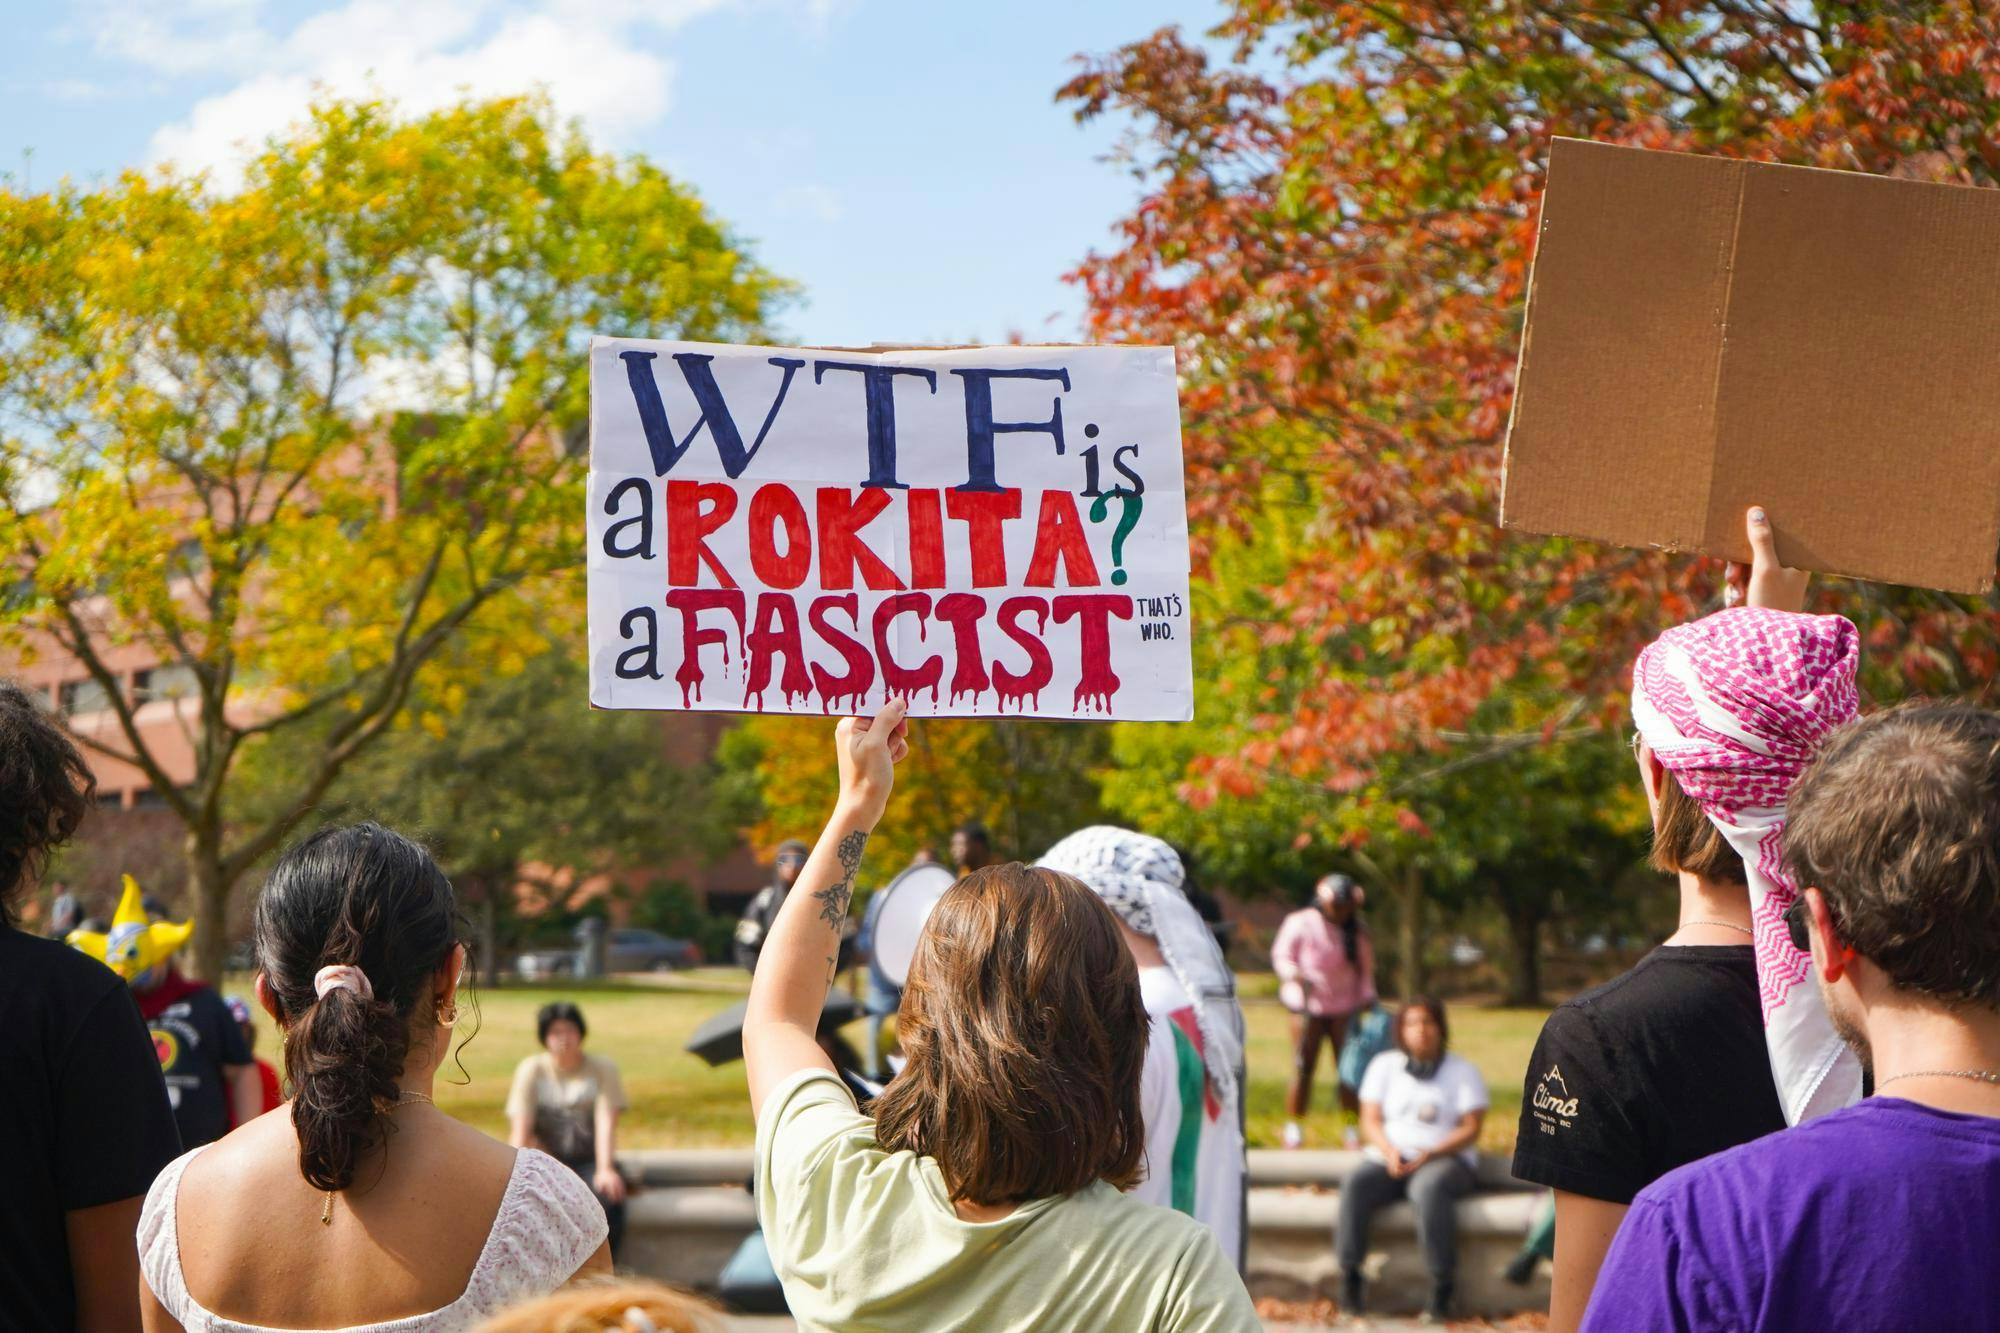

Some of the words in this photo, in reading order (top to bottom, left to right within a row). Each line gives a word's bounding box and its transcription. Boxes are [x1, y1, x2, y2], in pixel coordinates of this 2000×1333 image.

[619, 350, 1071, 493] WTF
[1079, 423, 1145, 499] is
[603, 477, 657, 560] a
[666, 480, 1143, 590] ROKITA?
[615, 606, 664, 680] a
[665, 588, 1134, 716] FASCIST
[1137, 592, 1182, 617] THAT'S
[1141, 622, 1175, 641] WHO.
